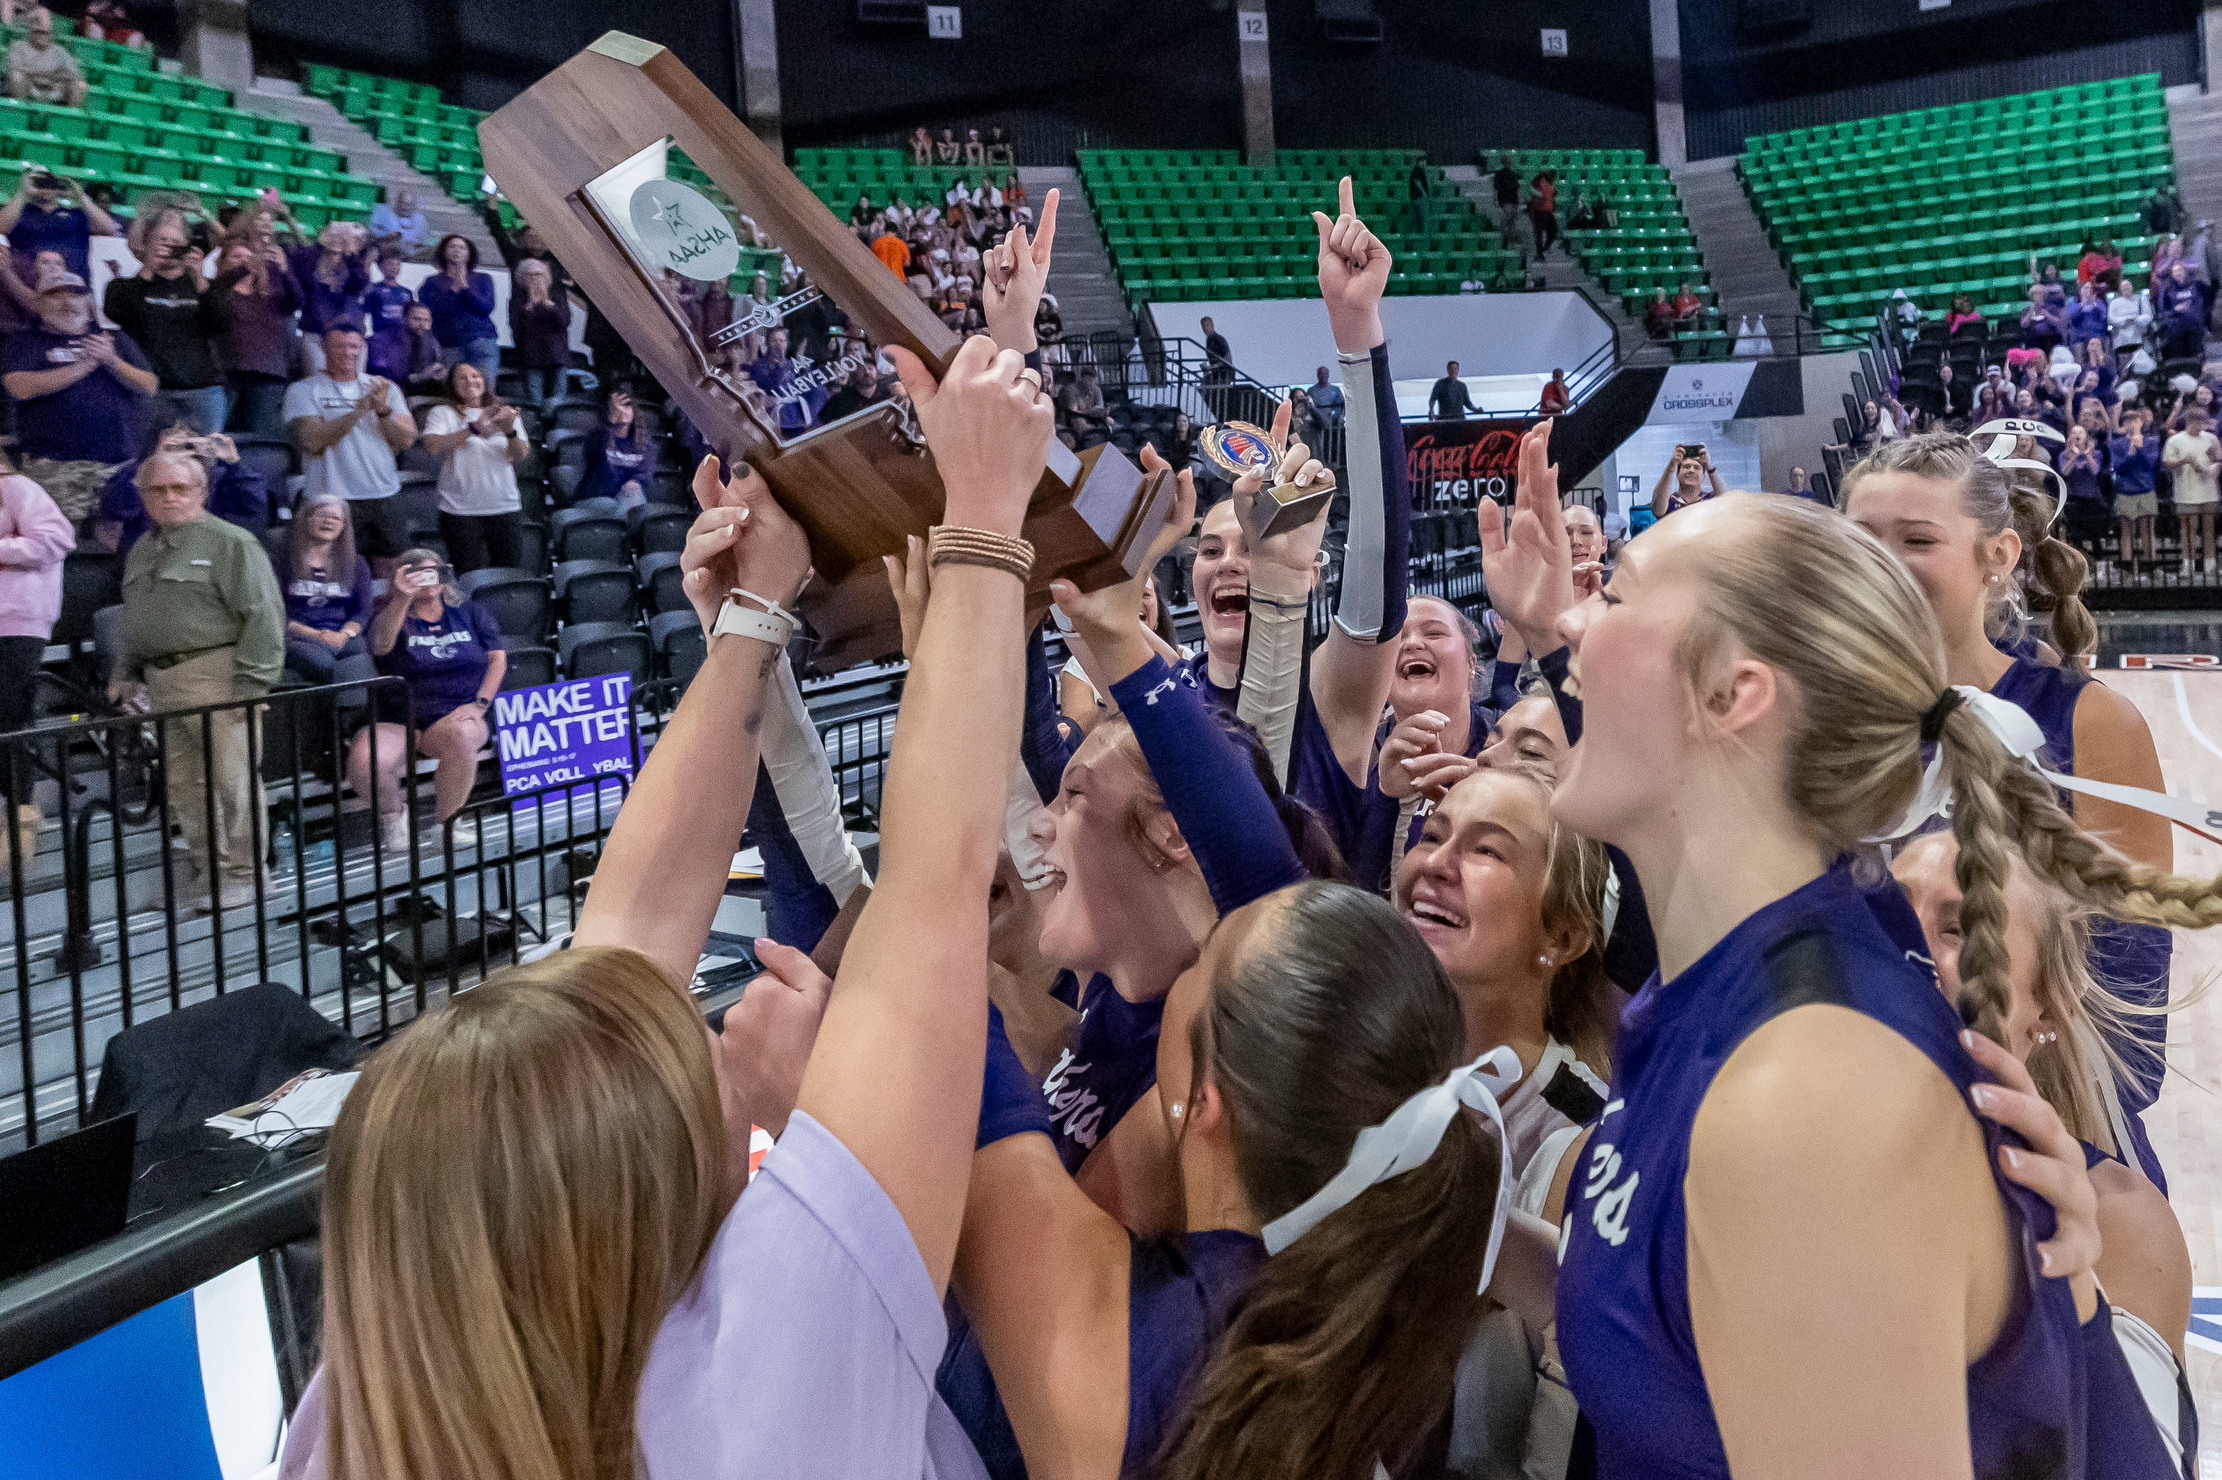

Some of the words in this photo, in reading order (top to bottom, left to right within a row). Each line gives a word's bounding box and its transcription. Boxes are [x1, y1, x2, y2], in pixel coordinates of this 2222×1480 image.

[937, 14, 954, 31] 11
[1244, 19, 1263, 35] 12
[1547, 36, 1563, 50] 13
[1663, 397, 1734, 410] CROSSPLEX
[1434, 477, 1506, 501] zero
[494, 682, 595, 727] MAKE
[602, 676, 631, 706] IT
[506, 774, 542, 794] PCA
